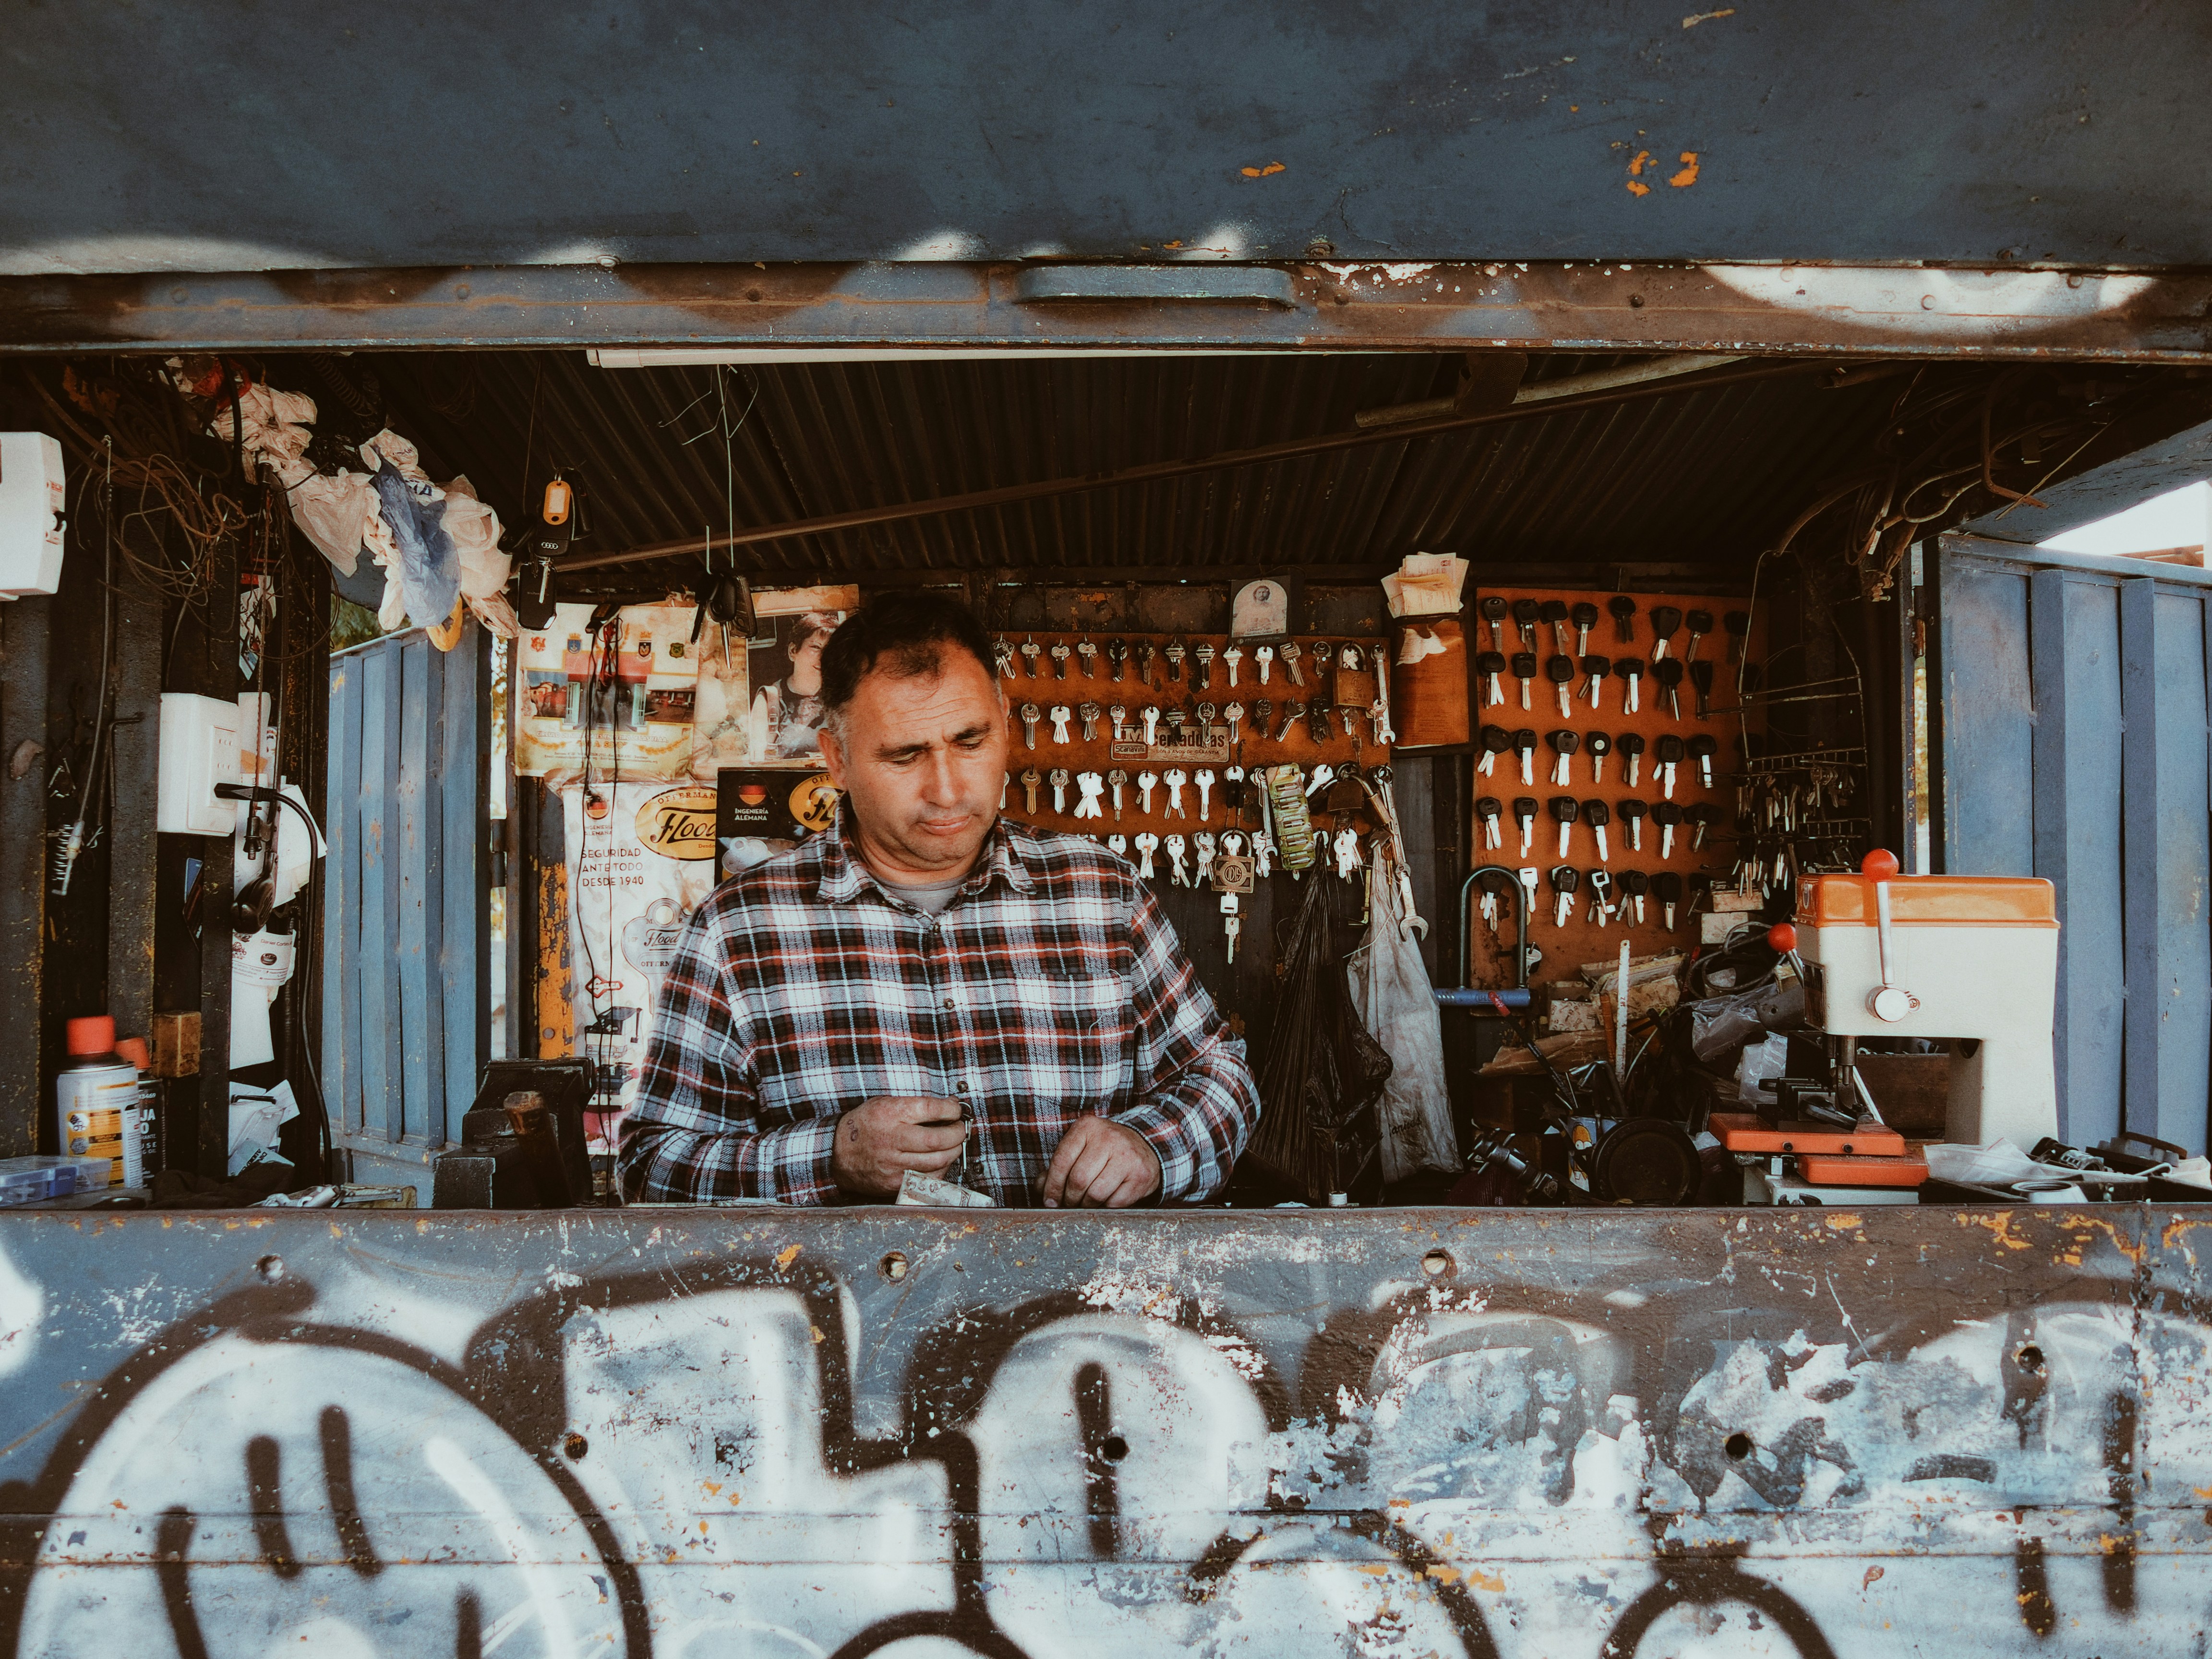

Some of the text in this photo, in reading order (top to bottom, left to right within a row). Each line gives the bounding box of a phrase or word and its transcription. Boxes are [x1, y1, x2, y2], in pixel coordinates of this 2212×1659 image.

[582, 848, 641, 858] SEGURIDAD
[582, 863, 643, 872] ANTE TODO
[583, 876, 643, 887] DESDE 1940
